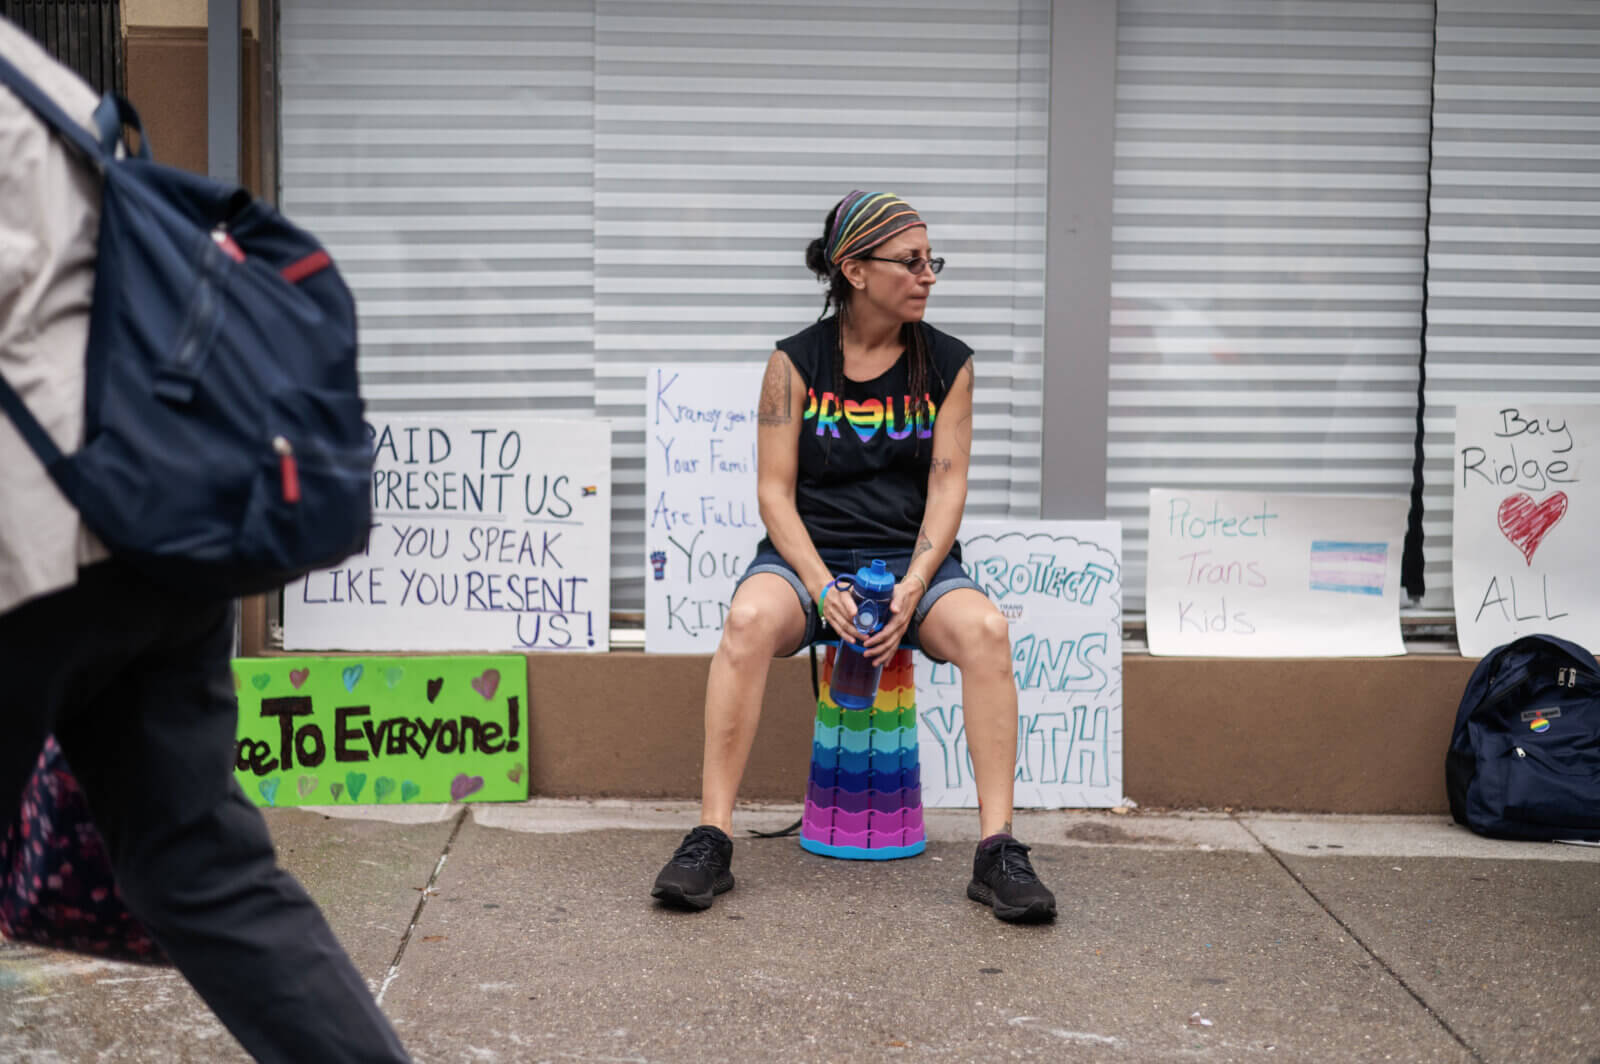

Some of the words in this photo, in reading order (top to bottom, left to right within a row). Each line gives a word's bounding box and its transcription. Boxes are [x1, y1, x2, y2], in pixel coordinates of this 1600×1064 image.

[471, 430, 521, 470] TO
[1494, 408, 1573, 453] Bay
[656, 435, 699, 477] Your
[1461, 443, 1581, 492] Ridge
[525, 474, 573, 519] US
[651, 490, 695, 530] Are
[1168, 498, 1278, 540] Protect
[392, 524, 450, 560] YOU
[463, 527, 563, 569] SPEAK
[1178, 550, 1267, 588] Trans
[303, 567, 387, 605] LIKE
[400, 568, 458, 606] YOU
[464, 570, 588, 614] RESENT
[1475, 573, 1569, 623] ALL
[517, 611, 595, 648] US!
[1178, 596, 1256, 635] Kids
